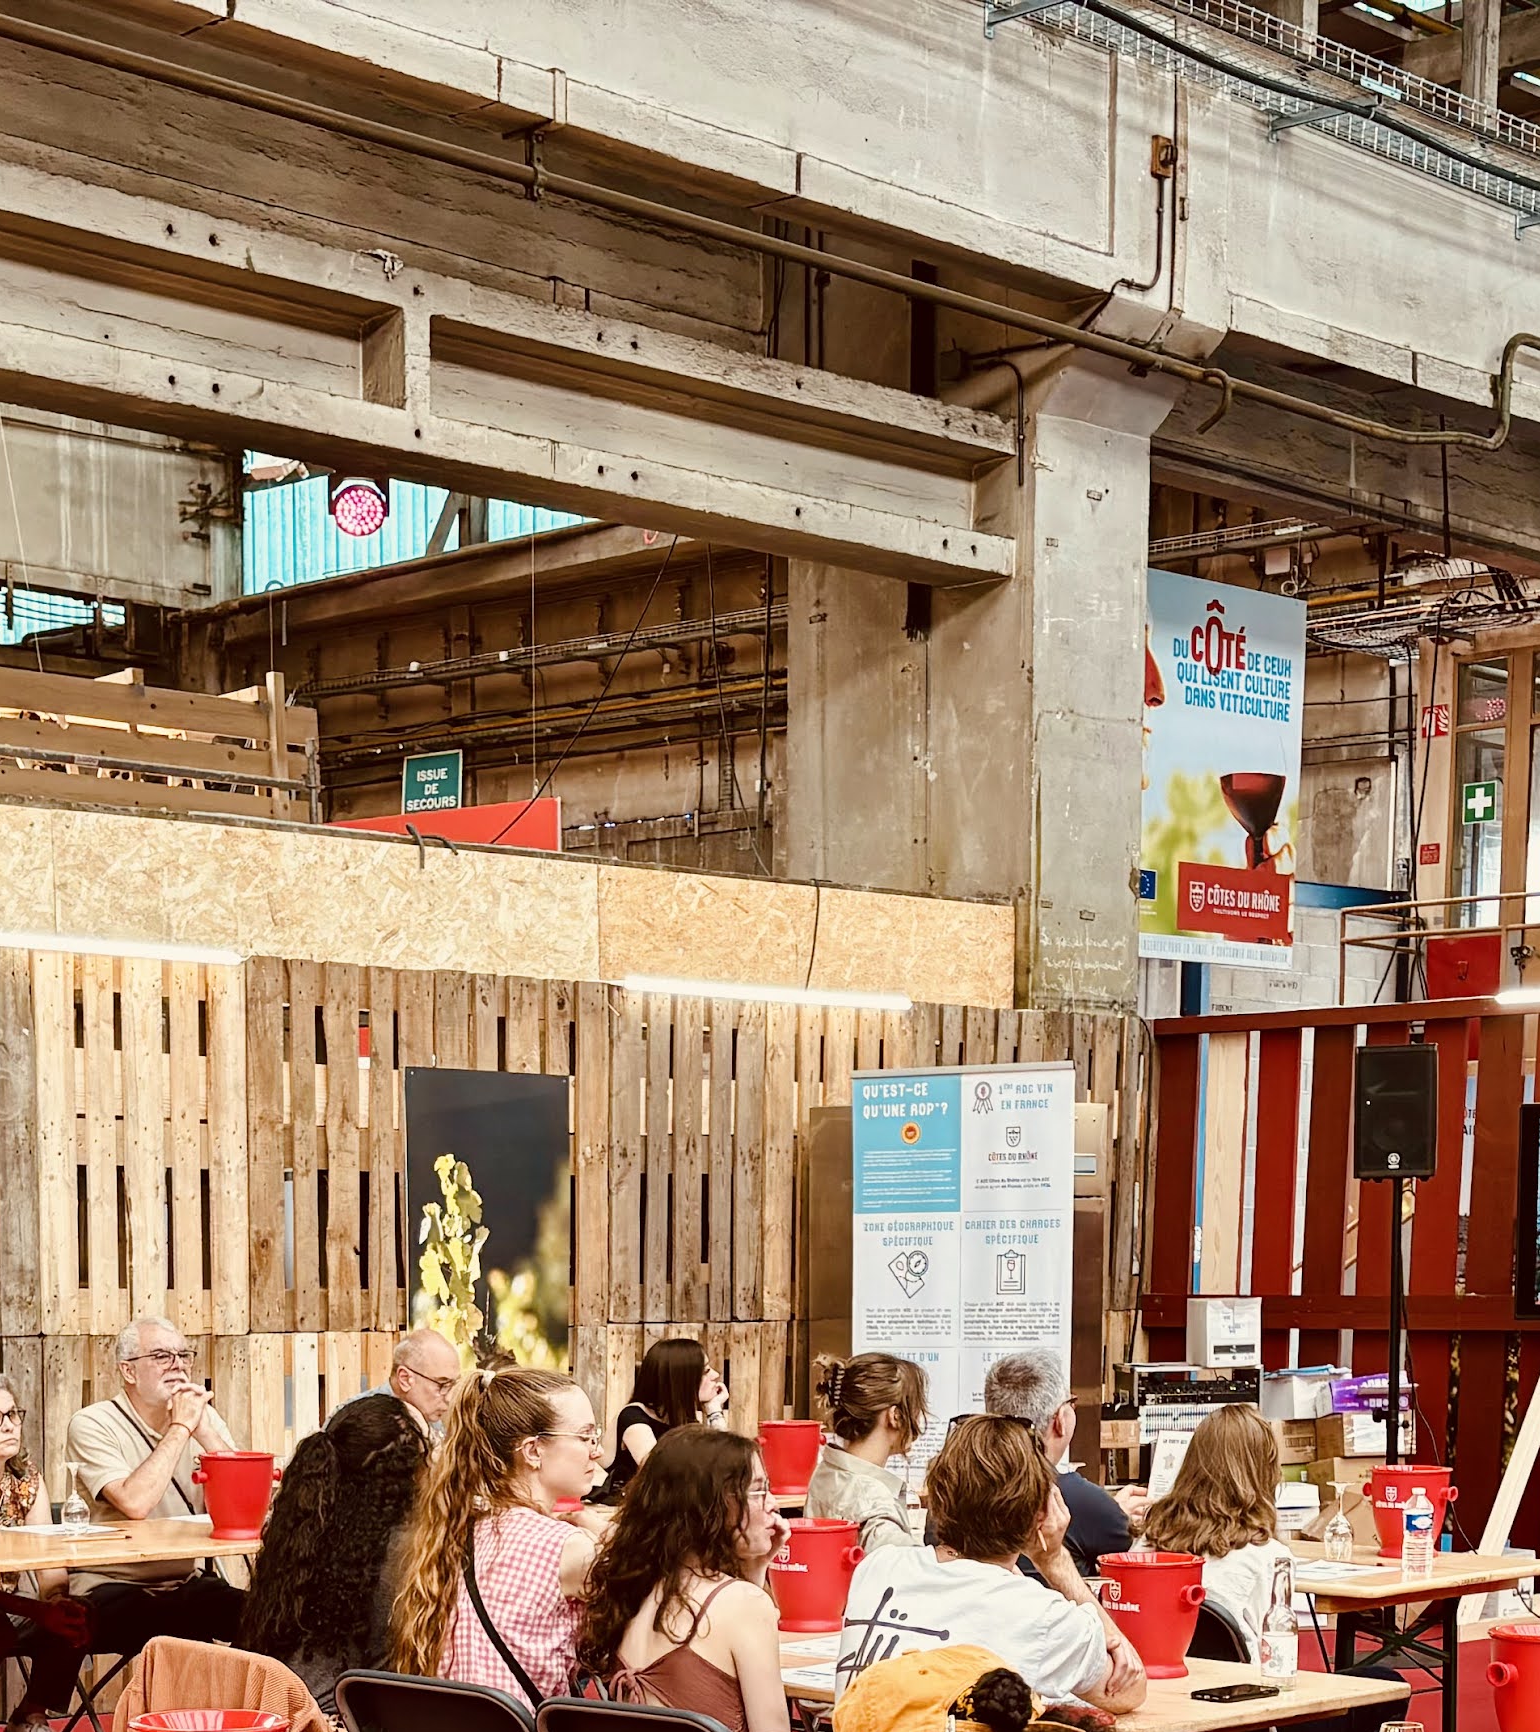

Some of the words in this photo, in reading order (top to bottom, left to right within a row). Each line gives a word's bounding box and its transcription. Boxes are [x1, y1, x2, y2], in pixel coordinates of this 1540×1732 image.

[1172, 637, 1189, 660] DU
[1190, 599, 1246, 675] CÔTÉ
[1247, 653, 1262, 673] DE
[1176, 661, 1199, 685] QUI
[1200, 664, 1243, 692] LISENT
[1244, 671, 1291, 701] CULTURE
[1184, 685, 1216, 709] DANS
[1218, 692, 1290, 722] VITICULTURE
[416, 767, 448, 782] ISSUE
[424, 783, 439, 795] DE
[406, 795, 457, 811] SECOURS
[1207, 883, 1236, 907] CÔTES
[1237, 890, 1250, 908] DU
[1251, 889, 1280, 913] RHÔNE
[863, 1082, 929, 1101] QU'EST-CE
[1036, 1083, 1054, 1093] VIN
[1001, 1100, 1013, 1110] EN
[1014, 1099, 1049, 1110] FRANCE
[863, 1102, 907, 1120] QU'UNE
[988, 1152, 1007, 1162] CÔTES
[1008, 1152, 1017, 1161] DU
[1017, 1150, 1038, 1161] RHÔNE
[887, 1220, 955, 1232] GÉOGRAPHIQUE
[964, 1219, 997, 1230] CAHIER
[999, 1218, 1017, 1229] DES
[1019, 1218, 1061, 1229] CHARGES
[882, 1235, 934, 1247] SPÉCIFIQUE
[985, 1233, 1039, 1245] SPÉCIFIQUE
[982, 1352, 992, 1362] LE
